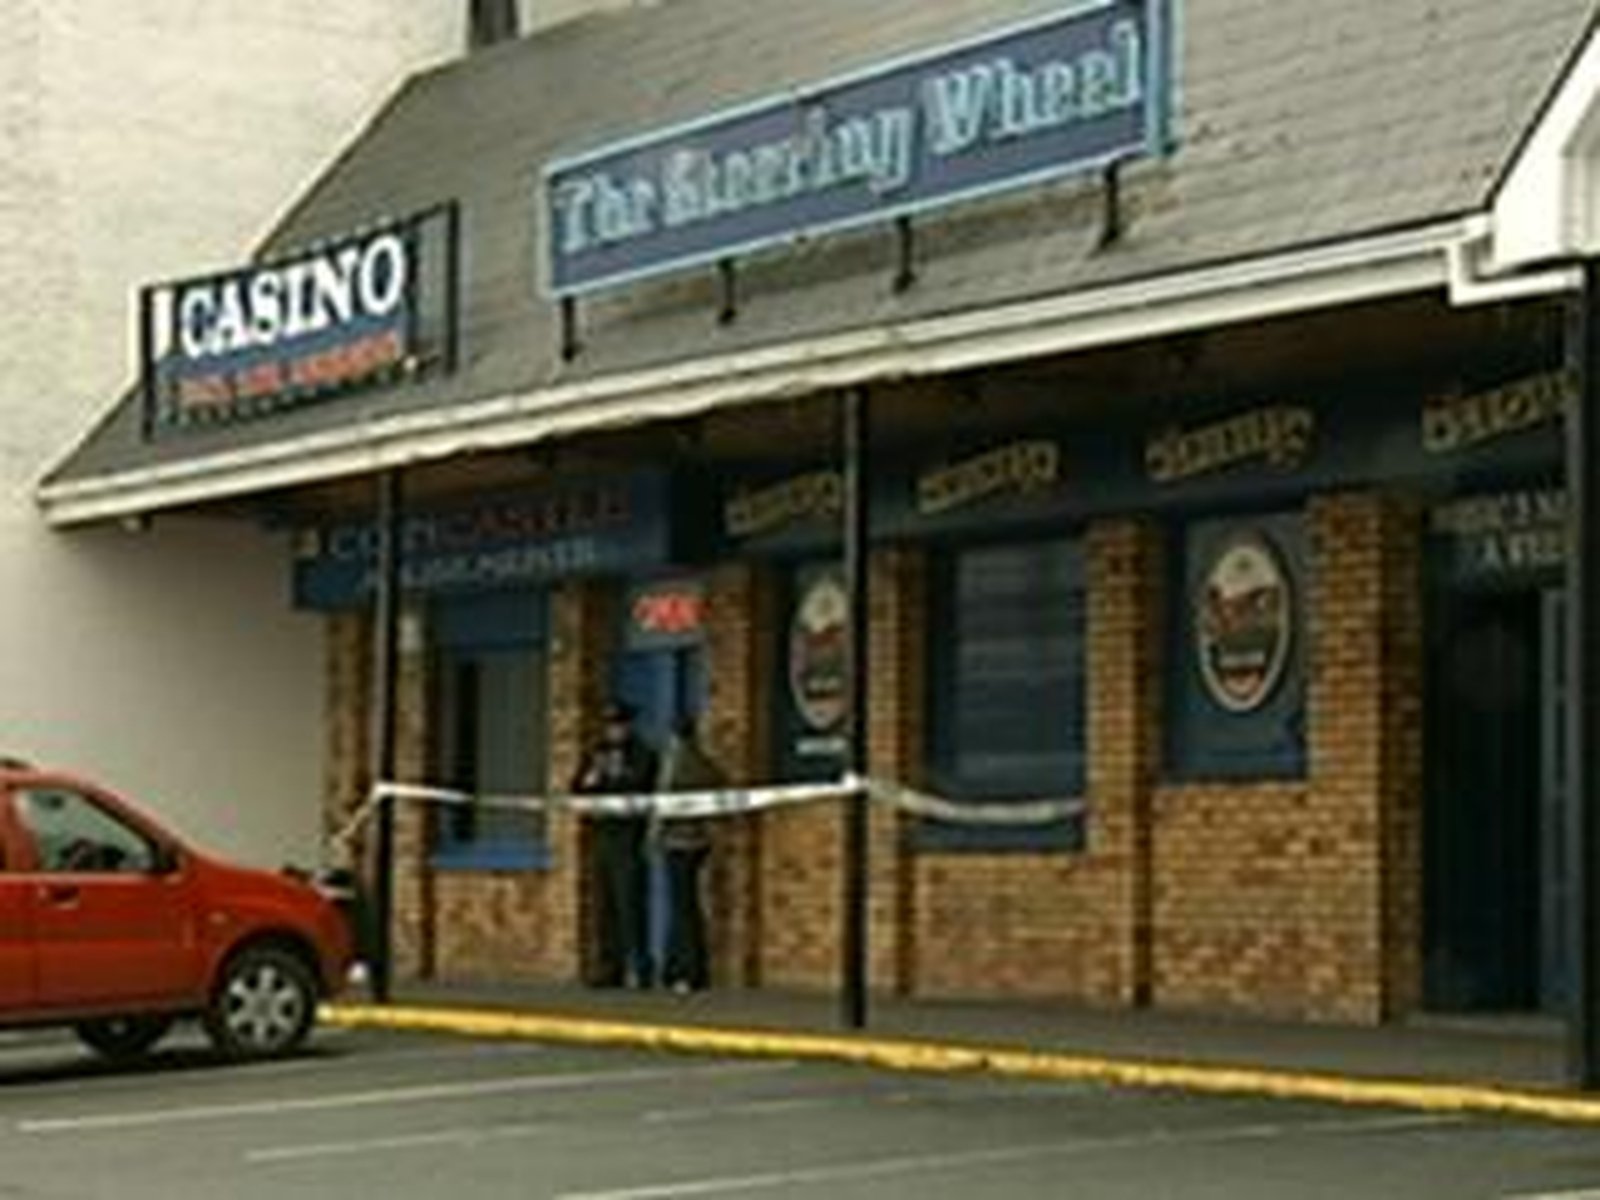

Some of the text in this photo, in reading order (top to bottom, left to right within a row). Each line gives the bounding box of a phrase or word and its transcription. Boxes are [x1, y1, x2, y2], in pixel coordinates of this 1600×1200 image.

[659, 108, 912, 226] Steering
[922, 20, 1142, 155] Wheel
[181, 234, 405, 358] CASINO
